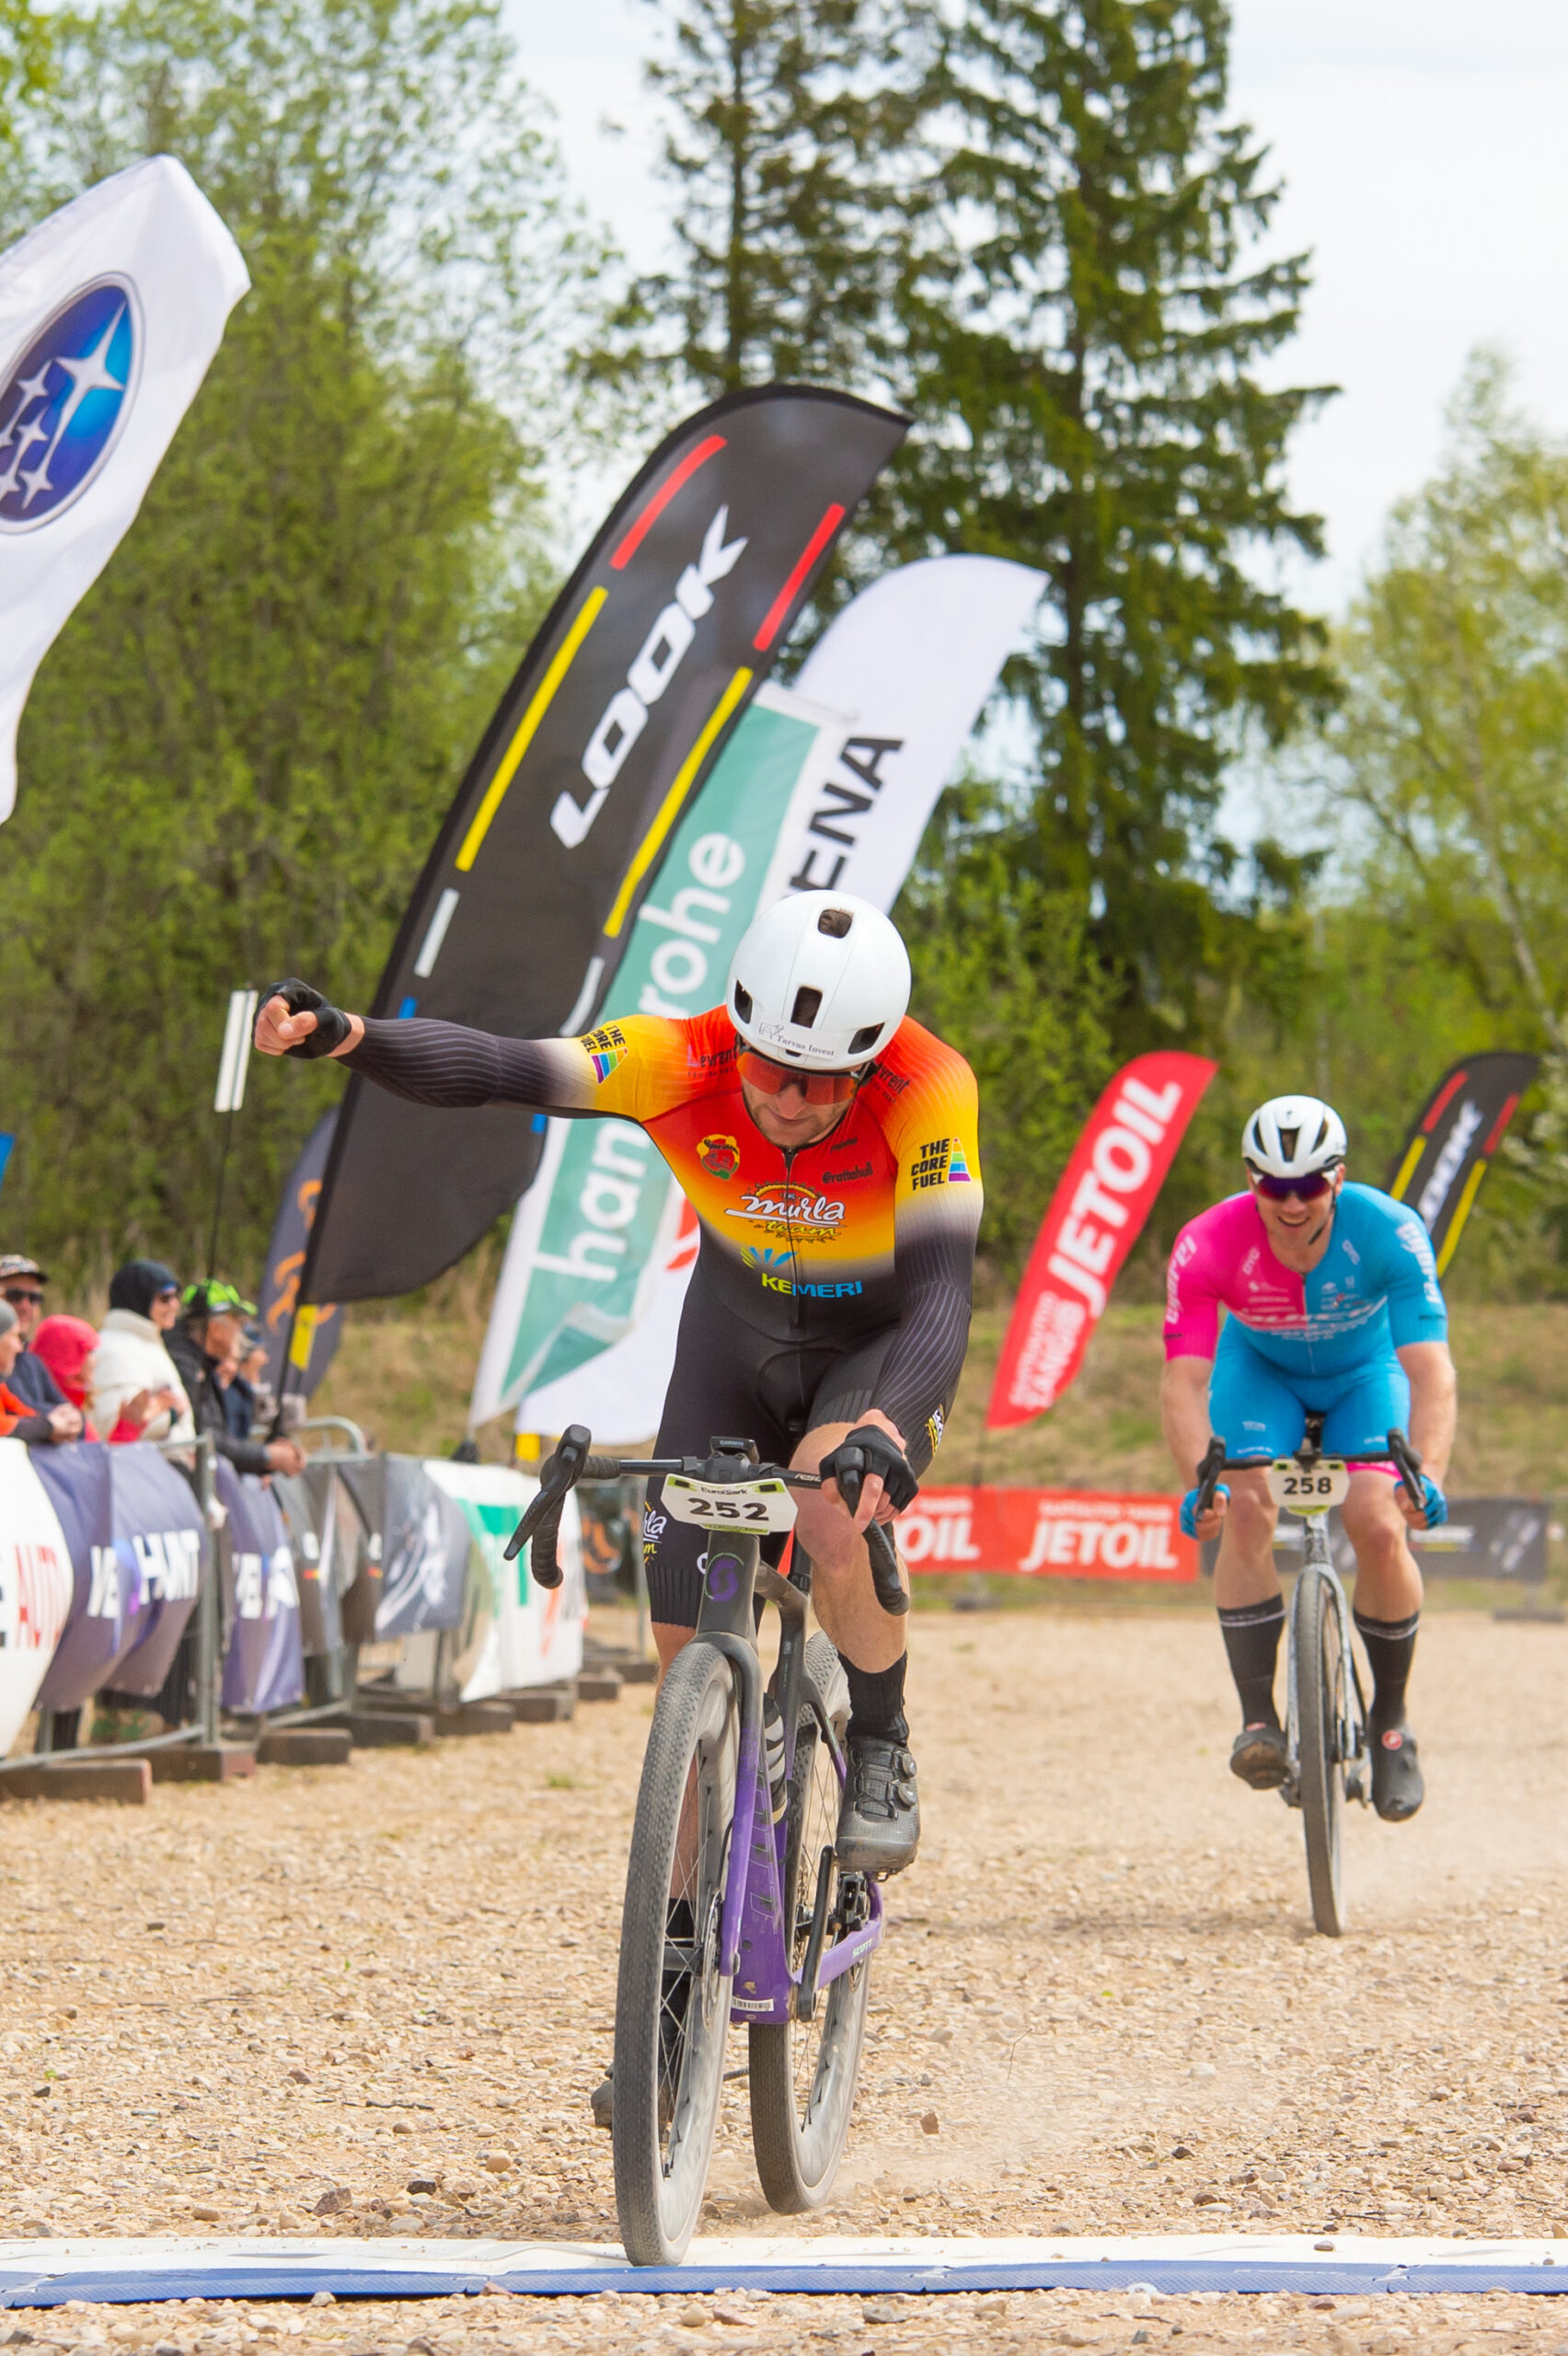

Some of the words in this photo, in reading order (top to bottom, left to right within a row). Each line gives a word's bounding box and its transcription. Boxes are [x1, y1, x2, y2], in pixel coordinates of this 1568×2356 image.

[550, 502, 749, 849] LOOK
[789, 737, 903, 890] ENA
[580, 1035, 597, 1053] UEL
[777, 1034, 806, 1049] Tarvas
[808, 1044, 835, 1057] Invest
[876, 1062, 911, 1095] vrent
[919, 1138, 950, 1159] THE
[911, 1155, 948, 1176] CORE
[912, 1172, 945, 1191] FUEL
[740, 1196, 846, 1226] murla
[1047, 1077, 1183, 1320] JETOIL
[762, 1273, 863, 1298] KEMERI
[1284, 1477, 1332, 1495] 258
[687, 1497, 769, 1521] 252
[895, 1517, 981, 1562] OIL
[1019, 1519, 1179, 1571] JETOIL
